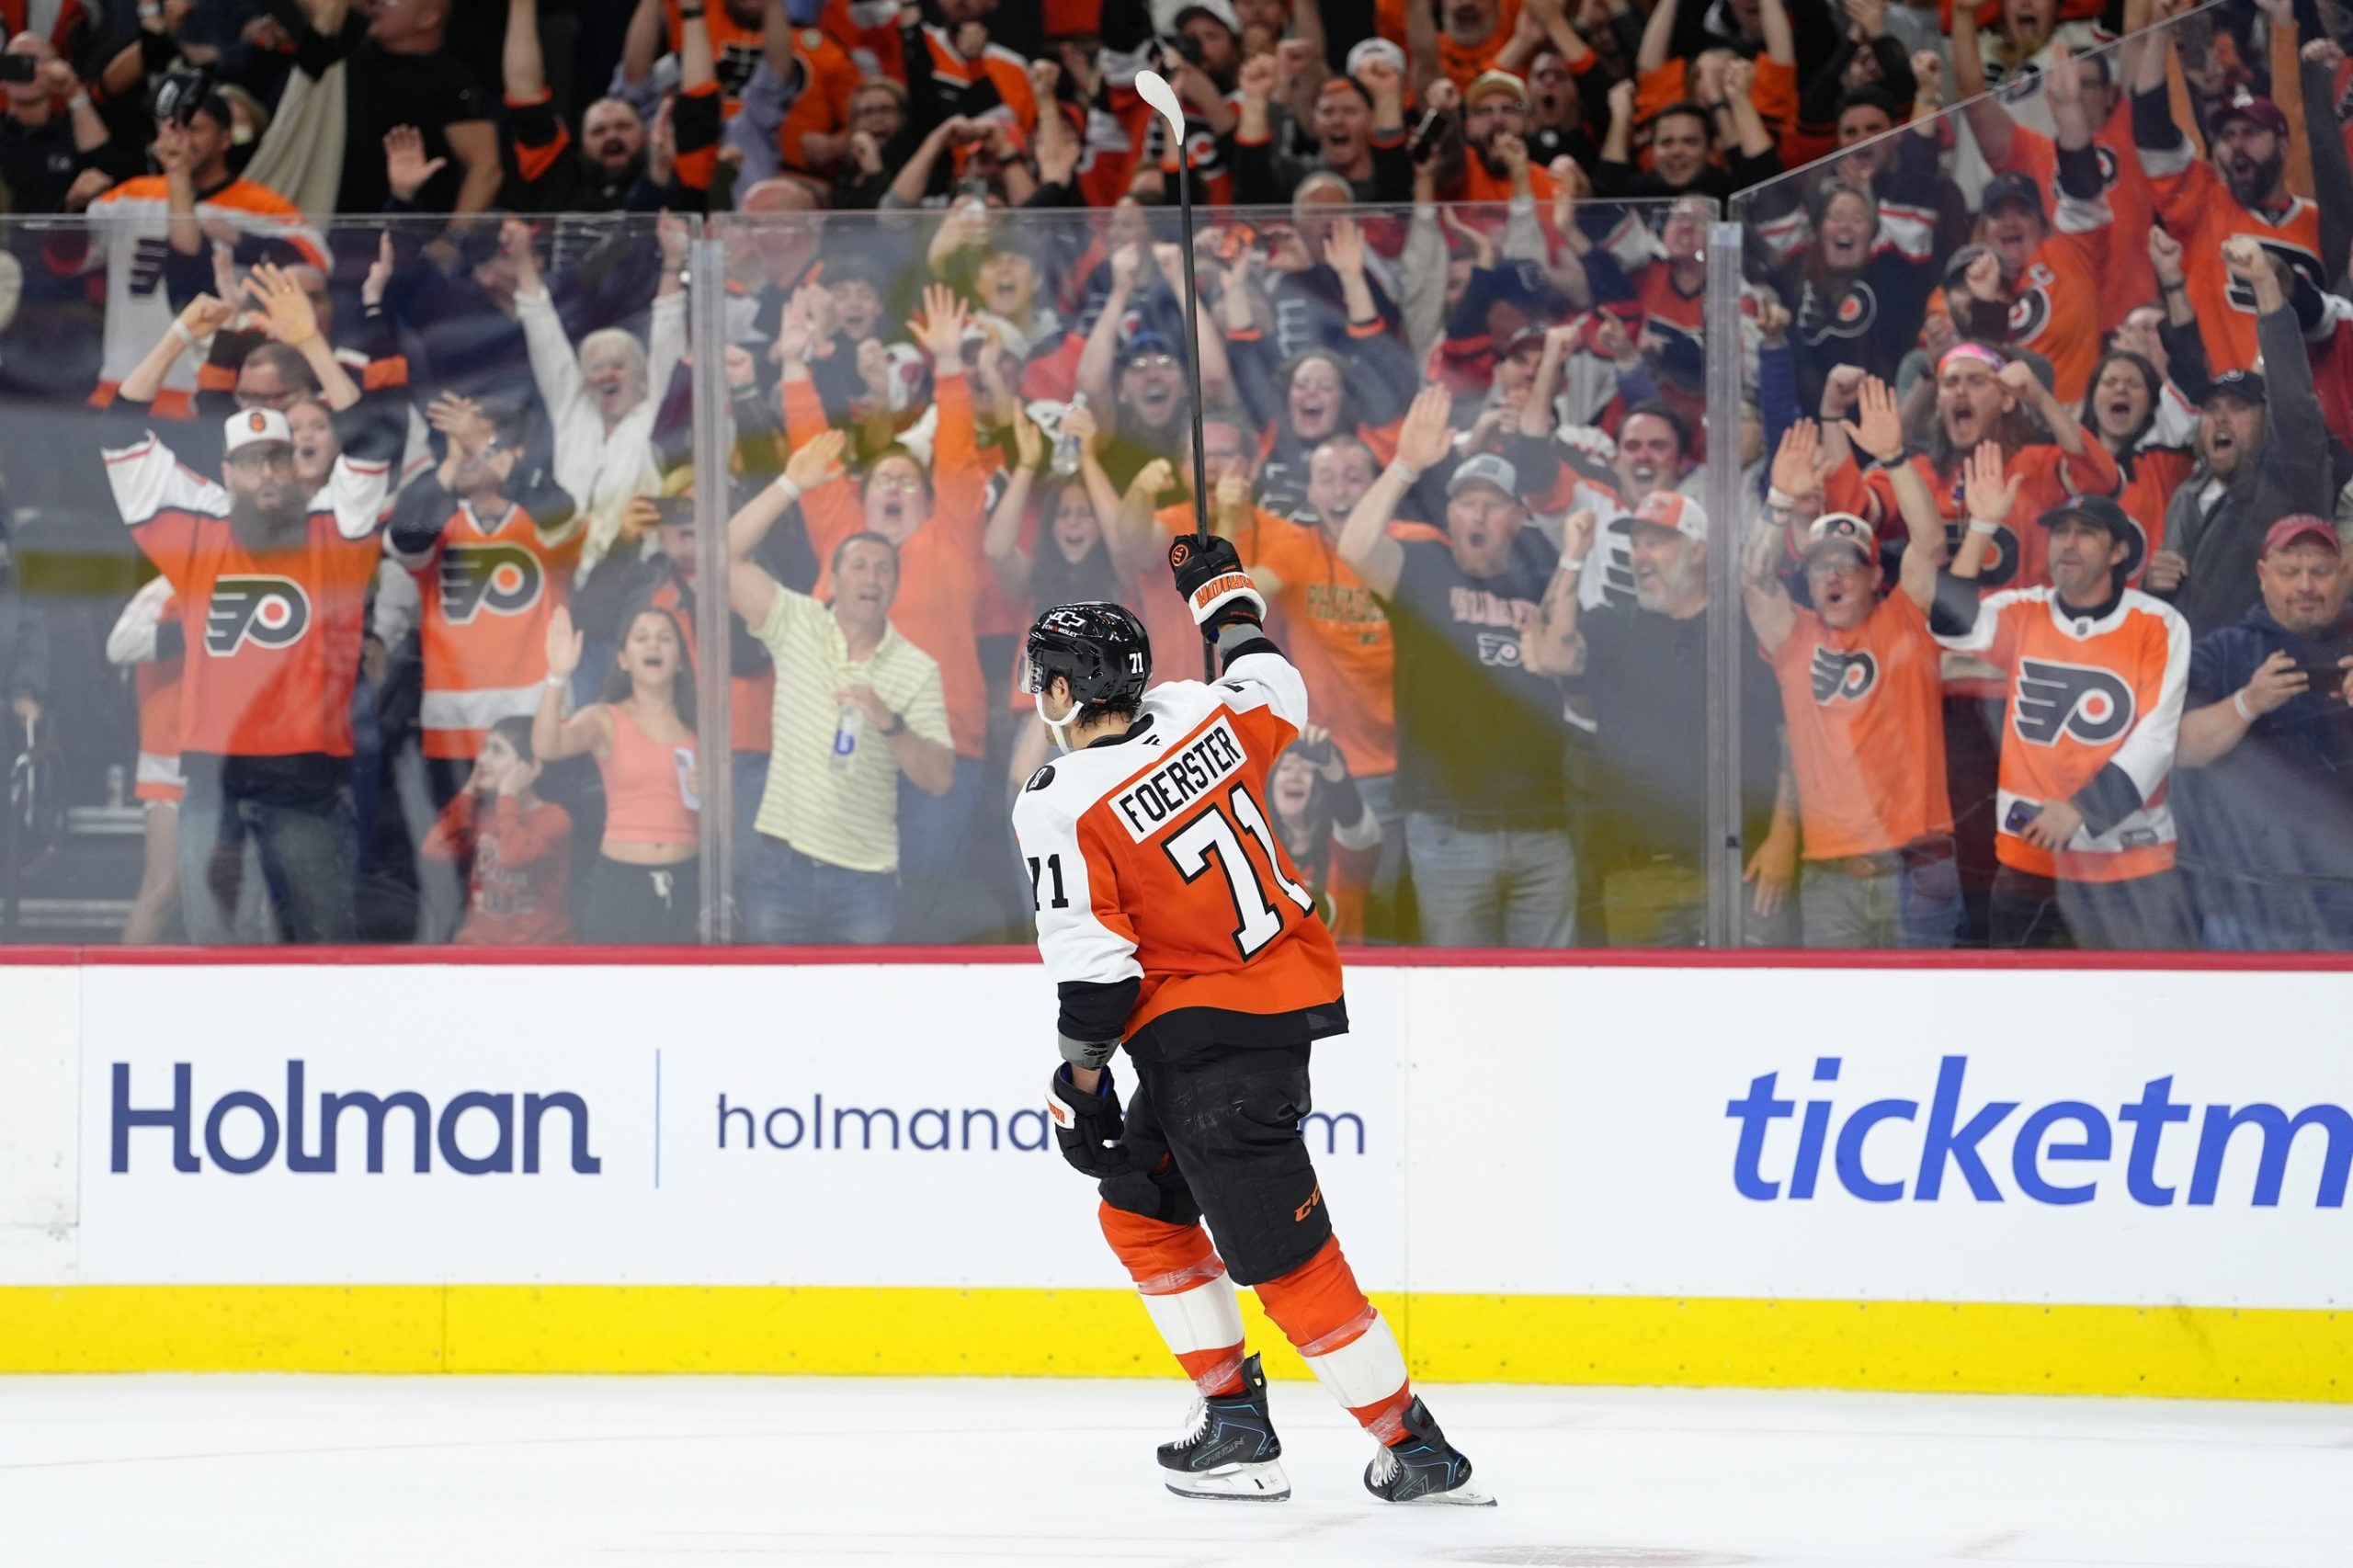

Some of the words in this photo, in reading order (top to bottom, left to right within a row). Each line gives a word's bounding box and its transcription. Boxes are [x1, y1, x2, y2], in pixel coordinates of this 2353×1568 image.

[1129, 652, 1144, 674] 71
[1119, 726, 1242, 834] FOERSTER
[1027, 853, 1069, 912] 71
[1160, 780, 1316, 963] 71
[111, 1060, 601, 1176] Holman
[1725, 1056, 2353, 1208] ticketm
[1294, 1183, 1321, 1221] CC
